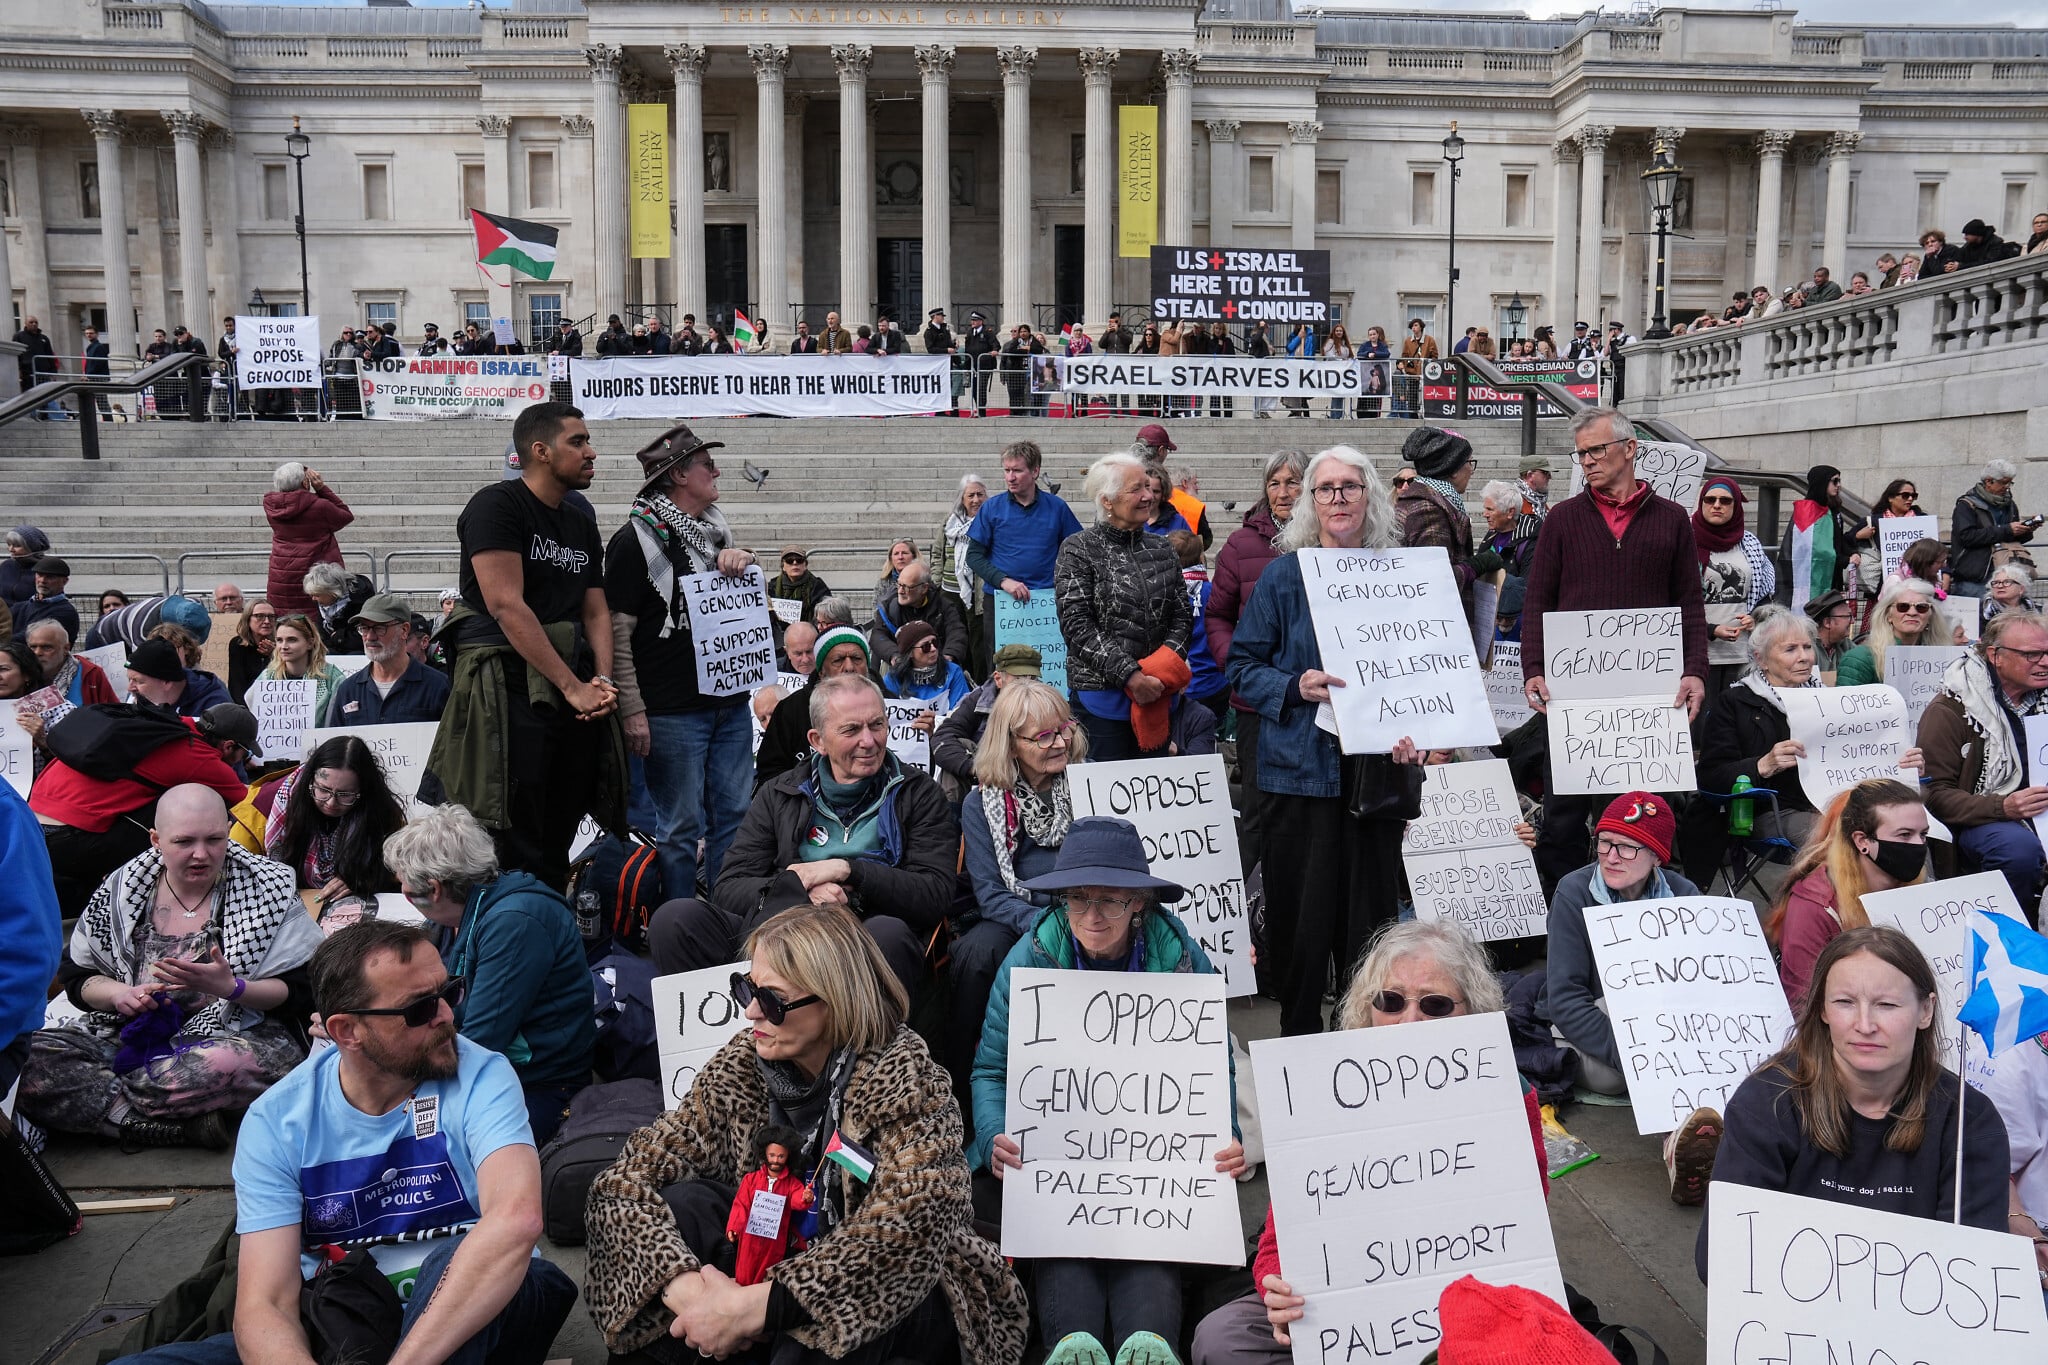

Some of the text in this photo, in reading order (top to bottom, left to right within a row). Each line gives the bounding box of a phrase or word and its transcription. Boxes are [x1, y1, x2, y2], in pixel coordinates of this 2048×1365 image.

[719, 8, 1066, 25] THE NATIONAL GALLERY
[640, 130, 651, 202] NATIONAL
[650, 130, 664, 203] GALLERY
[1129, 131, 1139, 202] NATIONAL
[1140, 131, 1152, 203] GALLERY
[1170, 275, 1310, 297] HERE TO KILL
[259, 324, 295, 334] IT'S OUR
[260, 338, 296, 348] DUTY TO
[253, 350, 304, 364] OPPOSE
[362, 359, 543, 377] STOP ARMING ISRAEL
[1444, 362, 1456, 371] UK
[1536, 361, 1576, 371] DEMAND
[247, 370, 313, 385] GENOCIDE
[582, 374, 941, 398] JURORS DESERVE TO HEAR THE WHOLE TRUTH
[1066, 365, 1358, 389] ISRAEL STARVES KIDS
[1537, 373, 1567, 383] BANK
[376, 385, 526, 398] STOP FUNDING GENOCIDE
[394, 396, 505, 407] END THE OCCUPATION
[1448, 386, 1498, 400] HNDS
[1443, 404, 1502, 416] SACTION
[1884, 530, 1924, 541] I OPPOSE
[1314, 556, 1405, 577] I OPPOSE
[694, 572, 759, 593] I OPPOSE
[1327, 582, 1430, 602] GENOCIDE
[700, 591, 764, 615] GENOCIDE
[1000, 598, 1056, 610] I OPPOS
[1000, 617, 1058, 630] GENOCID
[1335, 619, 1455, 649] I SUPPORT
[1584, 612, 1682, 638] I OPPOSE
[700, 627, 769, 656] I SUPPORT
[1032, 643, 1067, 654] PPORT
[1494, 645, 1521, 656] TIRED
[706, 648, 771, 678] PALESTINE
[1551, 648, 1675, 678] GENOCIDE
[1891, 657, 1896, 676] I
[714, 668, 764, 692] ACTION
[264, 704, 309, 717] SUPPORT
[887, 705, 925, 721] POSE
[1379, 692, 1455, 722] ACTION
[1494, 709, 1527, 721] PPORT
[1815, 695, 1825, 718] I
[1840, 693, 1892, 715] OPPOSE
[1562, 707, 1677, 737] I SUPPORT
[1825, 717, 1900, 737] GENOCIDE
[256, 735, 302, 749] ACTION
[1565, 731, 1689, 763] PALESTINE
[1820, 742, 1900, 762] I SUPPORT
[1438, 767, 1448, 790] I
[1586, 761, 1682, 789] ACTION
[1826, 765, 1900, 786] PALESTINE
[1087, 771, 1214, 816] I OPPOSE
[1421, 788, 1500, 818] PPOSE
[1407, 814, 1521, 849] GENOCIDE
[1142, 824, 1222, 864] OCIDE
[1459, 850, 1468, 868] I
[1415, 859, 1532, 896] SUPPORT
[1174, 879, 1243, 923] PPORT
[1433, 891, 1546, 921] PALESTINE
[1596, 907, 1758, 947] I OPPOSE
[1893, 913, 1906, 934] I
[1604, 955, 1775, 989] GENOCIDE
[1020, 983, 1224, 1046] I OPPOSE
[1622, 1013, 1772, 1048] I SUPPORT
[1019, 1066, 1214, 1118] GENOCIDE
[1283, 1046, 1500, 1116] I OPPOSE
[1672, 1084, 1733, 1122] ACT
[417, 1112, 434, 1122] DEFY
[1012, 1126, 1218, 1164] I SUPPORT
[364, 1172, 442, 1202] METROPOLITAN
[1036, 1170, 1217, 1198] PALESTINE
[1306, 1142, 1475, 1215] GENOCIDE
[1837, 1184, 1855, 1192] your
[1859, 1187, 1874, 1196] dog
[381, 1190, 435, 1208] POLICE
[1067, 1203, 1192, 1230] ACTION
[1323, 1224, 1517, 1285] I SUPPORT
[1737, 1211, 2030, 1334] I OPPOSE
[1320, 1307, 1442, 1365] PALES
